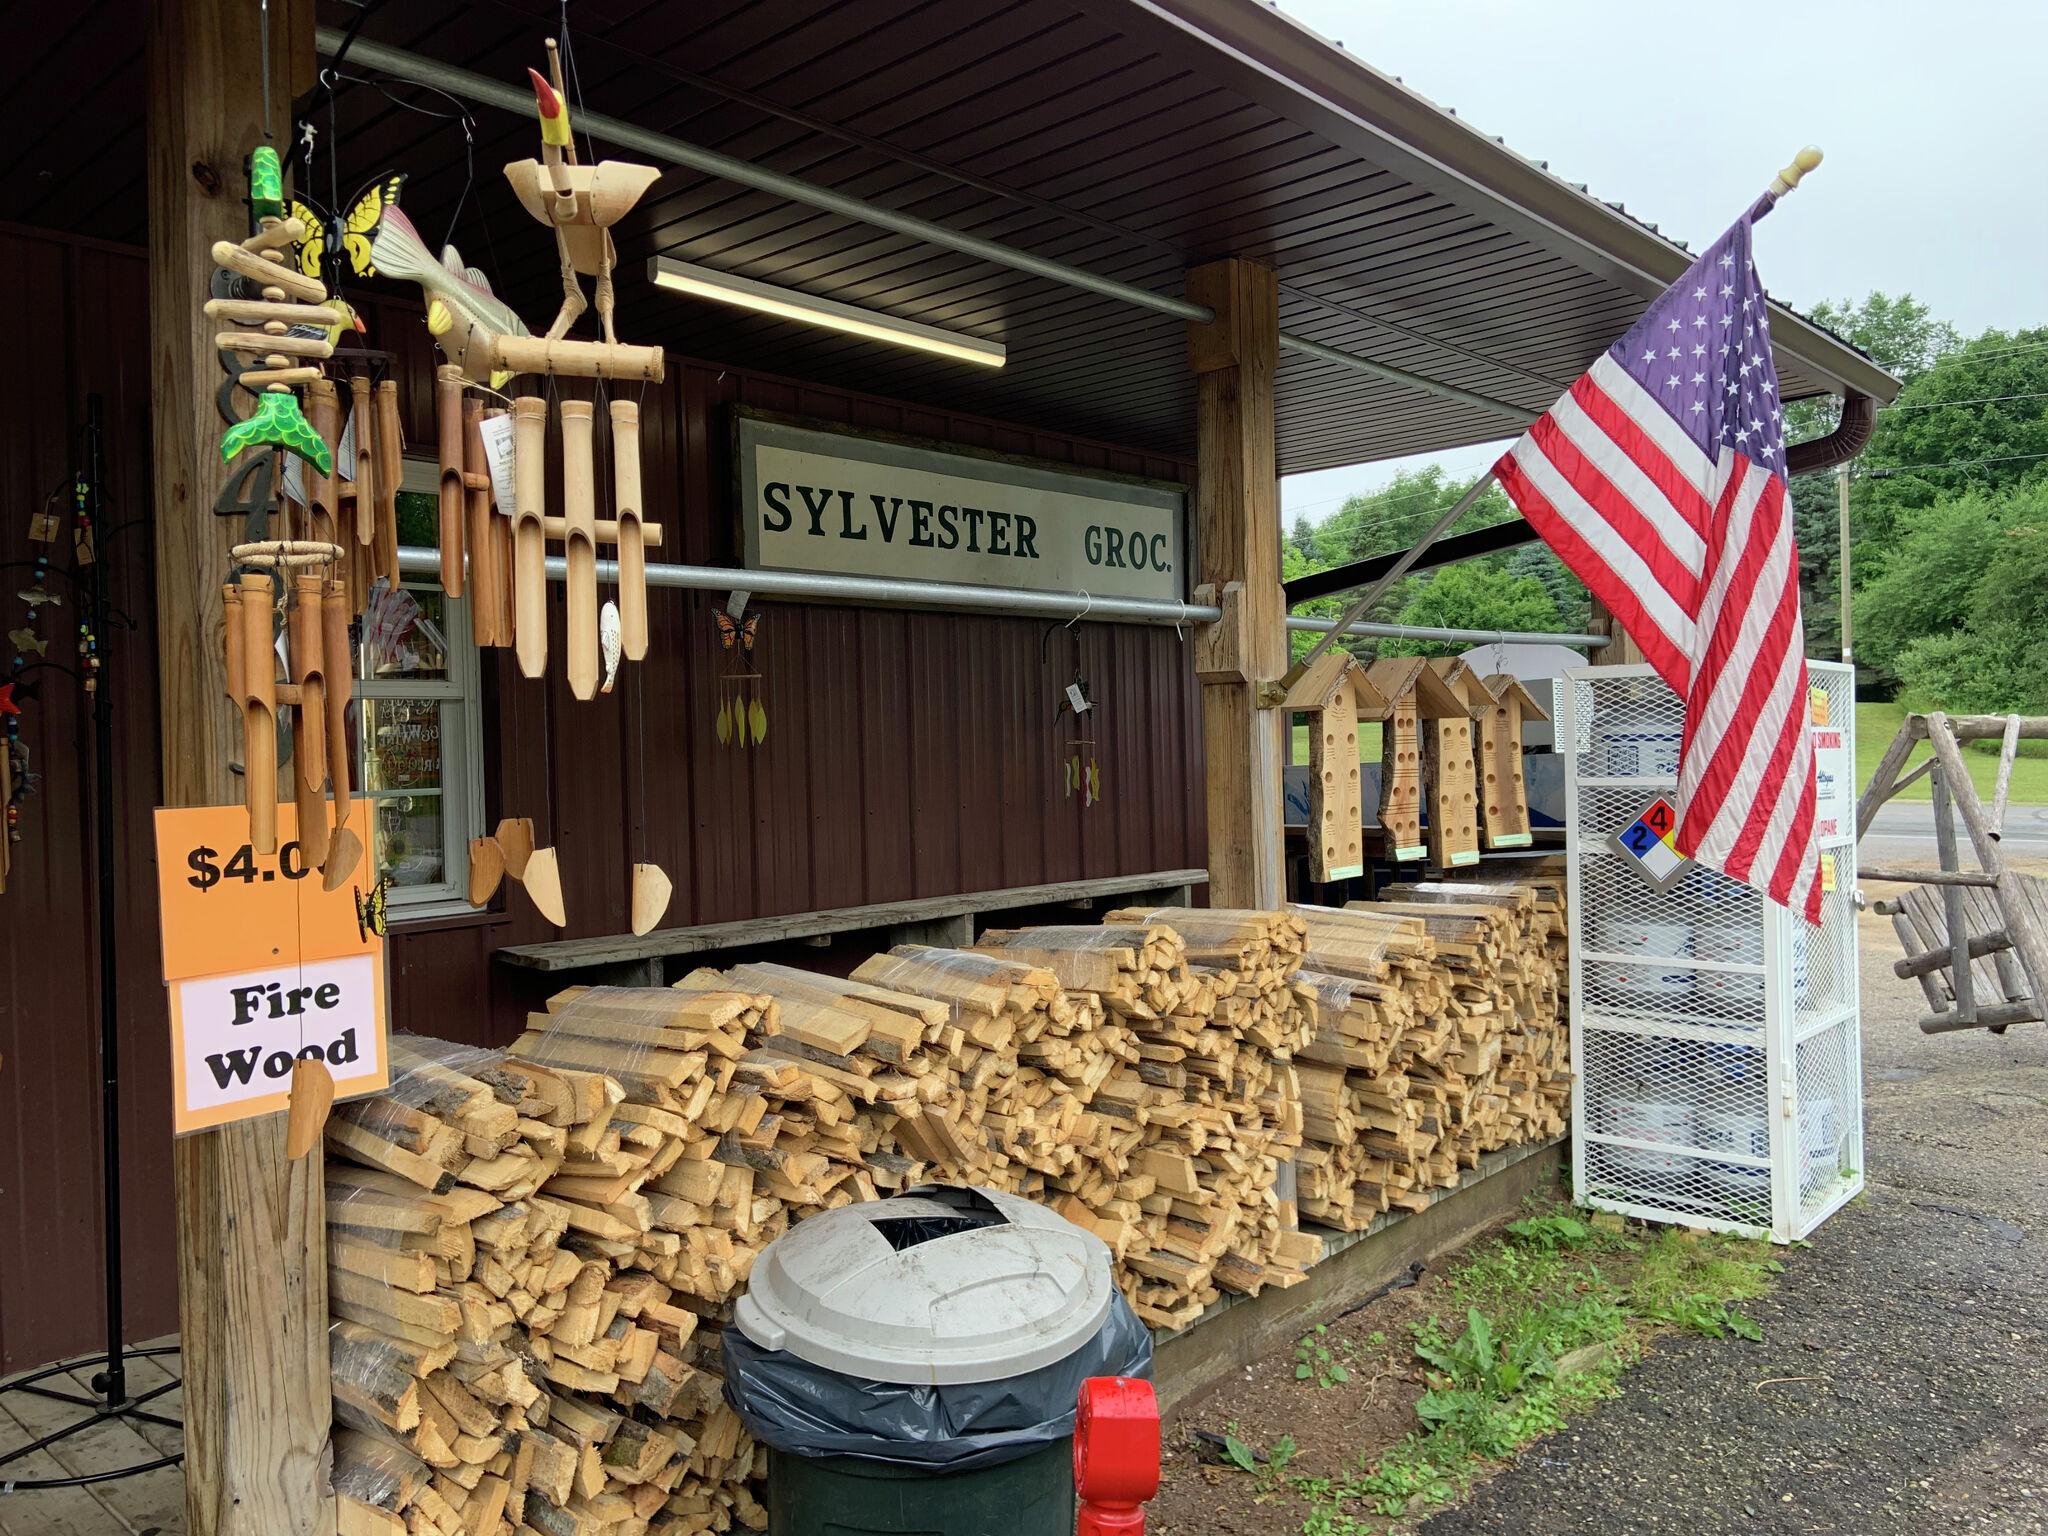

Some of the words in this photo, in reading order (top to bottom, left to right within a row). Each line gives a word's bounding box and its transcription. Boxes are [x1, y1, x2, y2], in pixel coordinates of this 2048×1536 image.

[763, 482, 1040, 559] SYLVESTER
[1084, 525, 1173, 573] GROC.
[1817, 732, 1841, 749] SMOKING
[1650, 806, 1668, 831] 4
[1820, 818, 1838, 837] OPANE
[1632, 826, 1648, 850] 2
[187, 841, 331, 893] $4.0
[230, 982, 341, 1026] Fire
[204, 1027, 360, 1090] Wood
